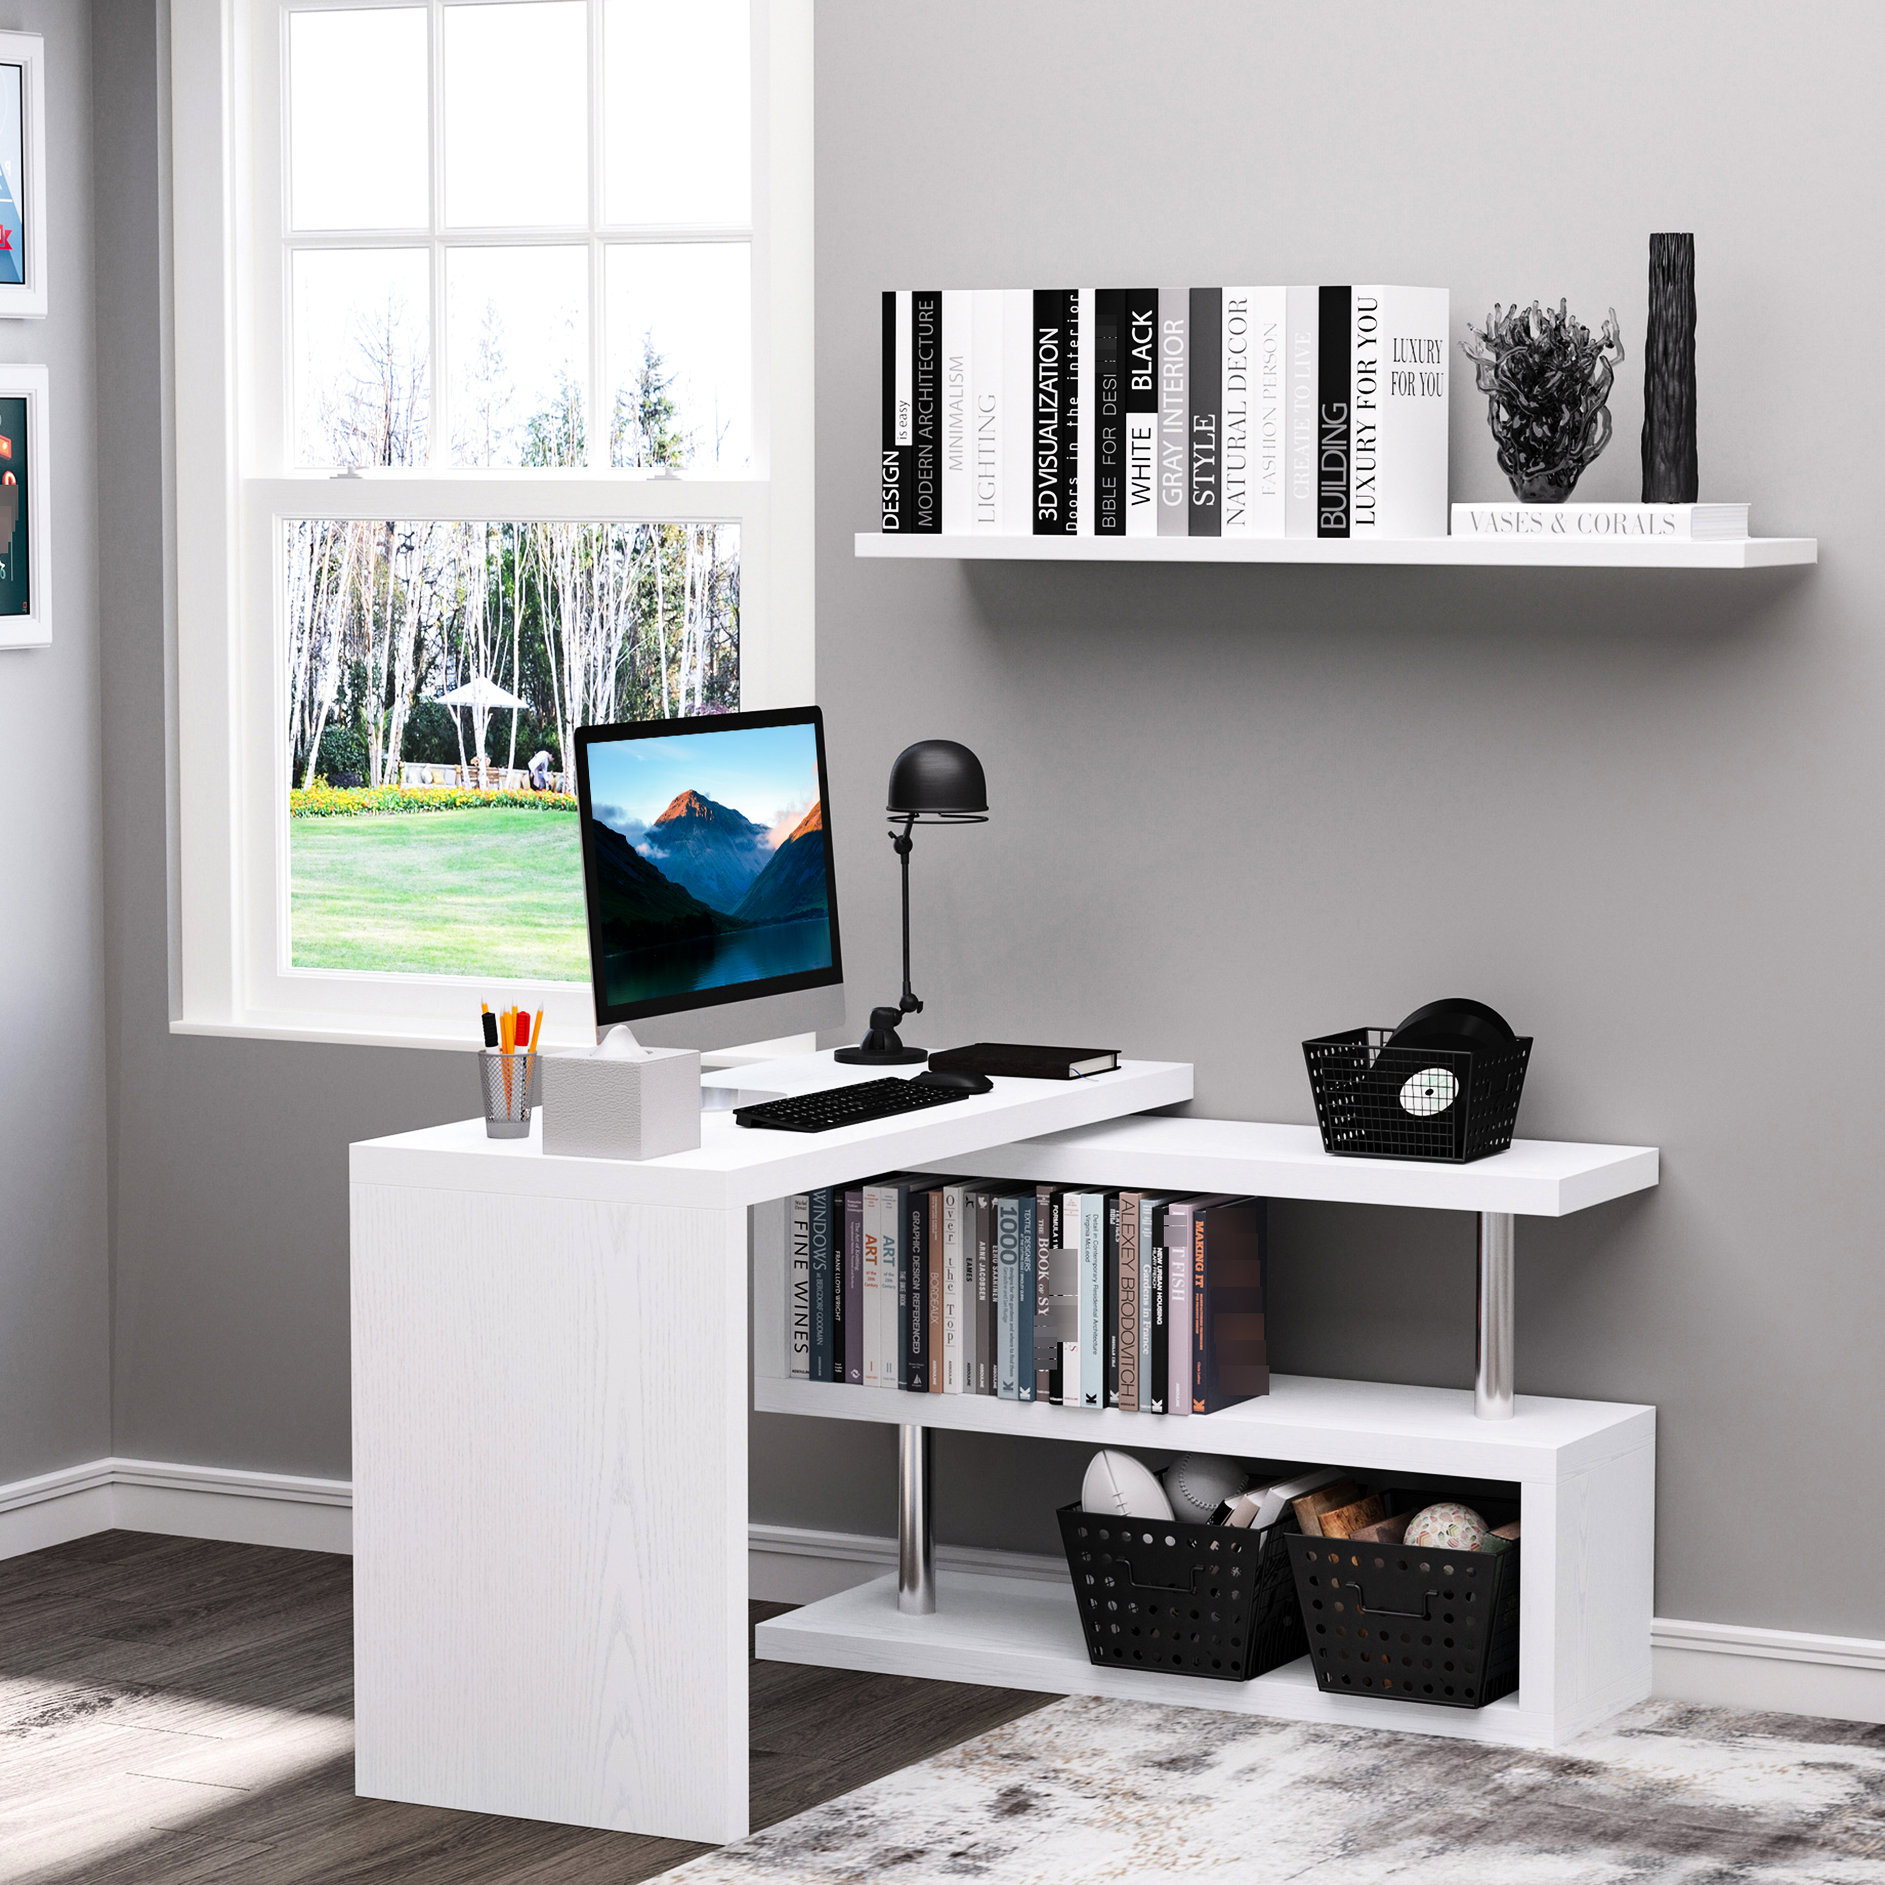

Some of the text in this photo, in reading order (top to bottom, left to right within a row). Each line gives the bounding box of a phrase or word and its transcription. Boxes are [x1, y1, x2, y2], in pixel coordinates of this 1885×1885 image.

[1131, 311, 1152, 390] BLACK
[1391, 371, 1444, 397] FOR YOU
[1393, 338, 1443, 364] LUXURY
[897, 400, 910, 440] is easy
[918, 300, 934, 526] MODERN ARCHITECTURE
[948, 356, 964, 471] MINIMALISM
[1039, 328, 1059, 521] 3D VISUALIZATION
[1065, 294, 1079, 531] Doors in the interior
[1162, 319, 1184, 506] GRAY INTERIOR
[1226, 297, 1248, 526] NATURAL DECOR
[1262, 322, 1277, 495] FASHION PERSON
[1292, 331, 1311, 499] CREATE TO LIVE
[1355, 297, 1378, 526] LUXURY FOR YOU
[978, 394, 996, 523] LIGHTING
[1102, 427, 1116, 465] FOR
[1131, 428, 1151, 505] WHITE
[1193, 414, 1216, 506] STYLE
[1321, 403, 1347, 529] BUILDING
[882, 451, 900, 530] DESIGN
[1102, 477, 1116, 528] BIBLE
[1470, 511, 1676, 535] VASES & CORALS
[794, 1221, 808, 1269] FINE
[812, 1190, 827, 1271] WINDOWS
[865, 1233, 878, 1266] ART
[883, 1235, 895, 1267] ART
[912, 1211, 920, 1253] GRAPHIC
[1000, 1207, 1018, 1265] 1000
[1038, 1238, 1049, 1281] BOOK
[1121, 1199, 1135, 1271] ALEXEY
[1195, 1221, 1204, 1271] MAKING
[912, 1255, 920, 1290] DESIGN
[930, 1272, 939, 1325] BORDEAUX
[1172, 1262, 1185, 1302] FISH
[1195, 1274, 1204, 1288] IT
[794, 1281, 808, 1353] WINES
[816, 1311, 824, 1345] GOODMAN
[912, 1293, 920, 1354] REFERENCED
[1121, 1277, 1135, 1397] BRODOVITCH
[1142, 1264, 1151, 1355] Gardens in France
